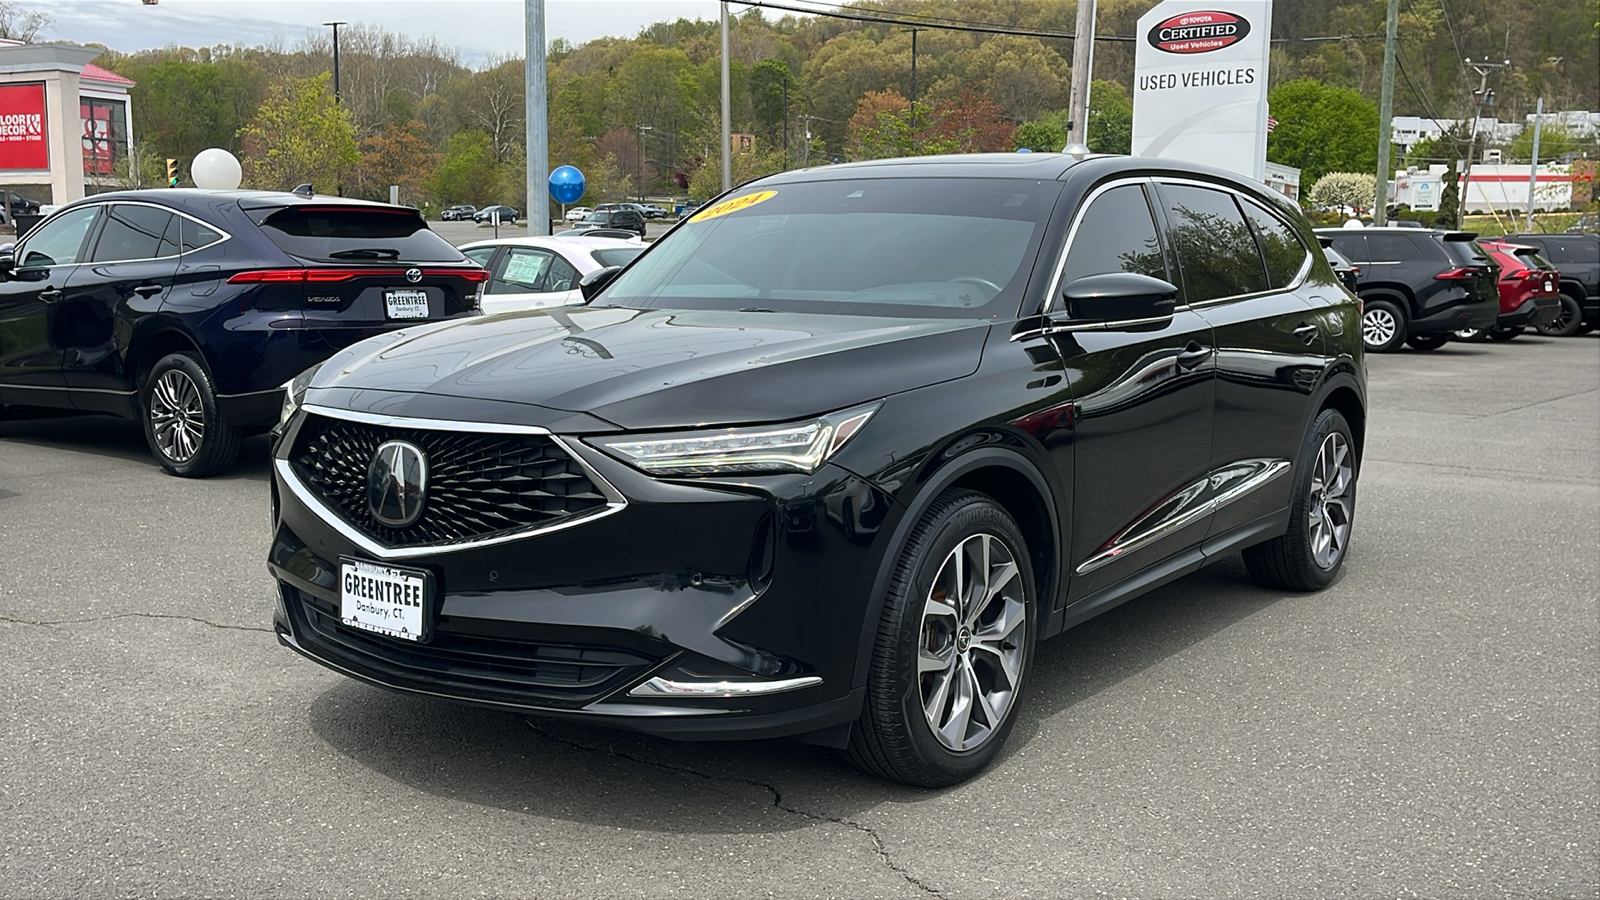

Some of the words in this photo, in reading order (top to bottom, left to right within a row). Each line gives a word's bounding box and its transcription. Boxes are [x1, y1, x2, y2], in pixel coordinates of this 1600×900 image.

[1189, 15, 1213, 24] TOYOTA
[1159, 24, 1237, 41] CERTIFIED
[1170, 42, 1189, 51] Used
[1190, 40, 1223, 49] Vehicles
[1140, 73, 1177, 91] USED
[1182, 68, 1255, 88] VEHICLES
[0, 114, 26, 125] LOOR
[388, 295, 426, 306] GREENTREE
[957, 507, 1018, 533] BRIDGESTONE
[345, 572, 420, 608] GREENTREE
[356, 600, 391, 620] Danbury,
[393, 607, 405, 620] CT.
[342, 618, 418, 641] GREENTREE
